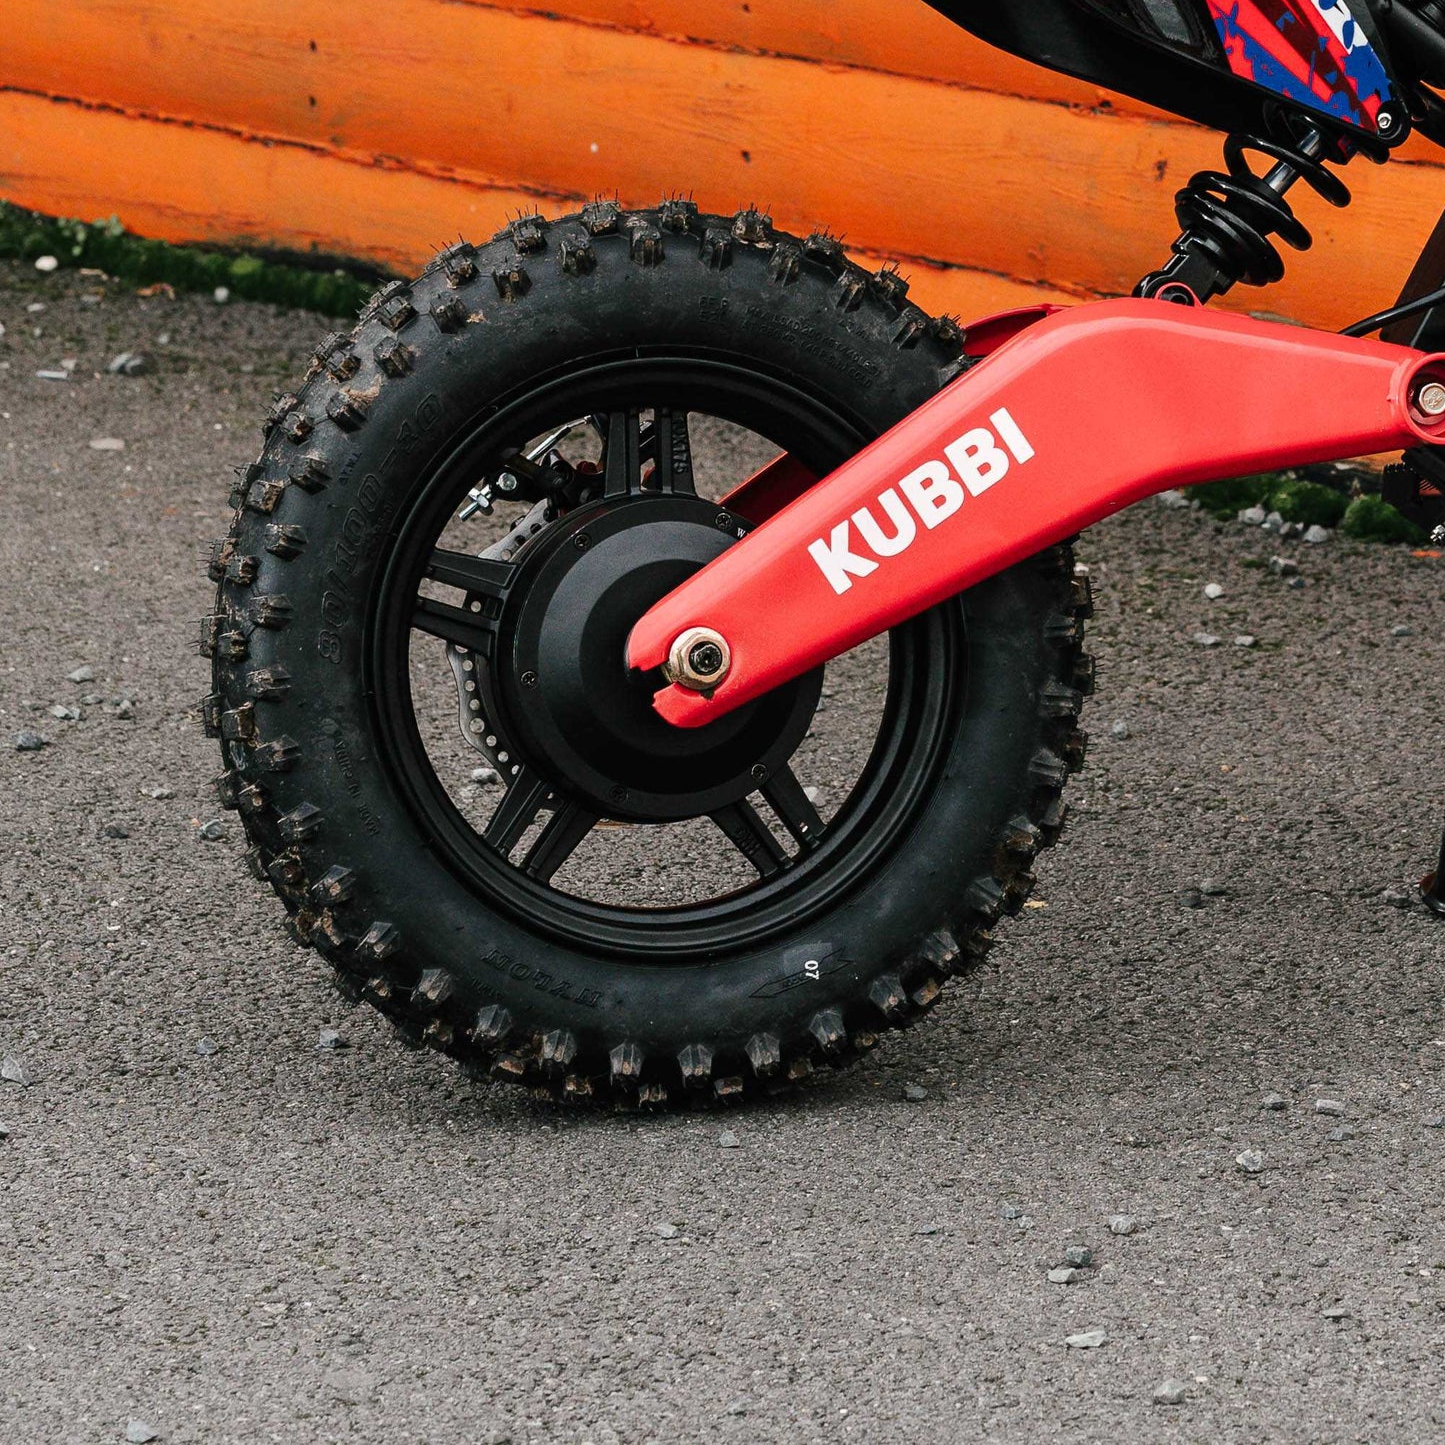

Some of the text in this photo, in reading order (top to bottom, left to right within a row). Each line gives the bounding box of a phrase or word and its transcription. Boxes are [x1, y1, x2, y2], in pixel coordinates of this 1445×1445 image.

[317, 391, 445, 665] 80/100-10
[806, 406, 1036, 596] KUBBI
[803, 959, 820, 981] 07
